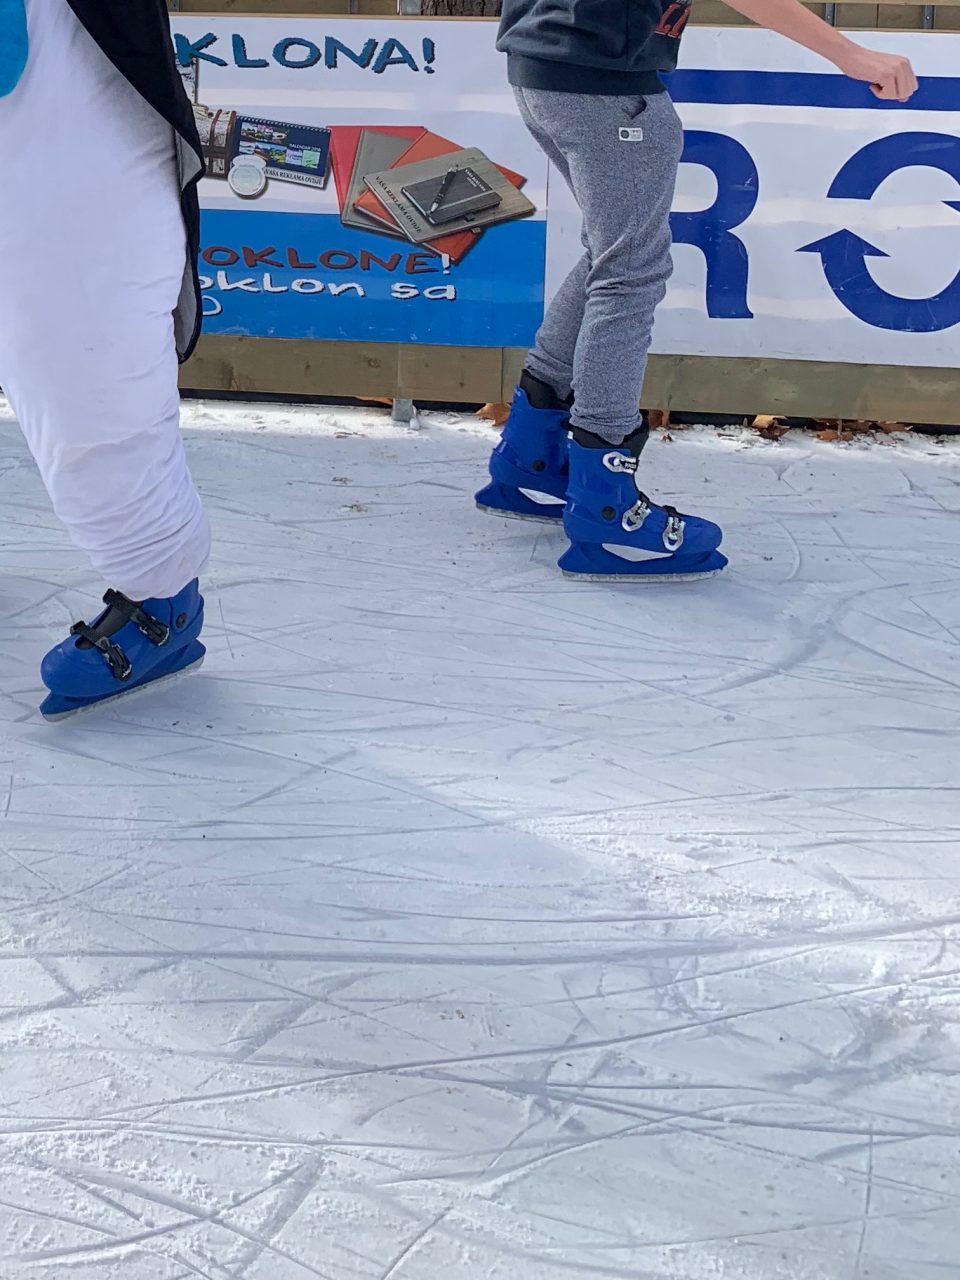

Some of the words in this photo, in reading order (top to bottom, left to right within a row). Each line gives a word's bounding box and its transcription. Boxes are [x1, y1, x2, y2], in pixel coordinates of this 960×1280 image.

[173, 32, 436, 74] KLONA!
[279, 170, 304, 182] REKLAMA
[200, 244, 451, 275] OKLONE!
[391, 281, 457, 301] sa
